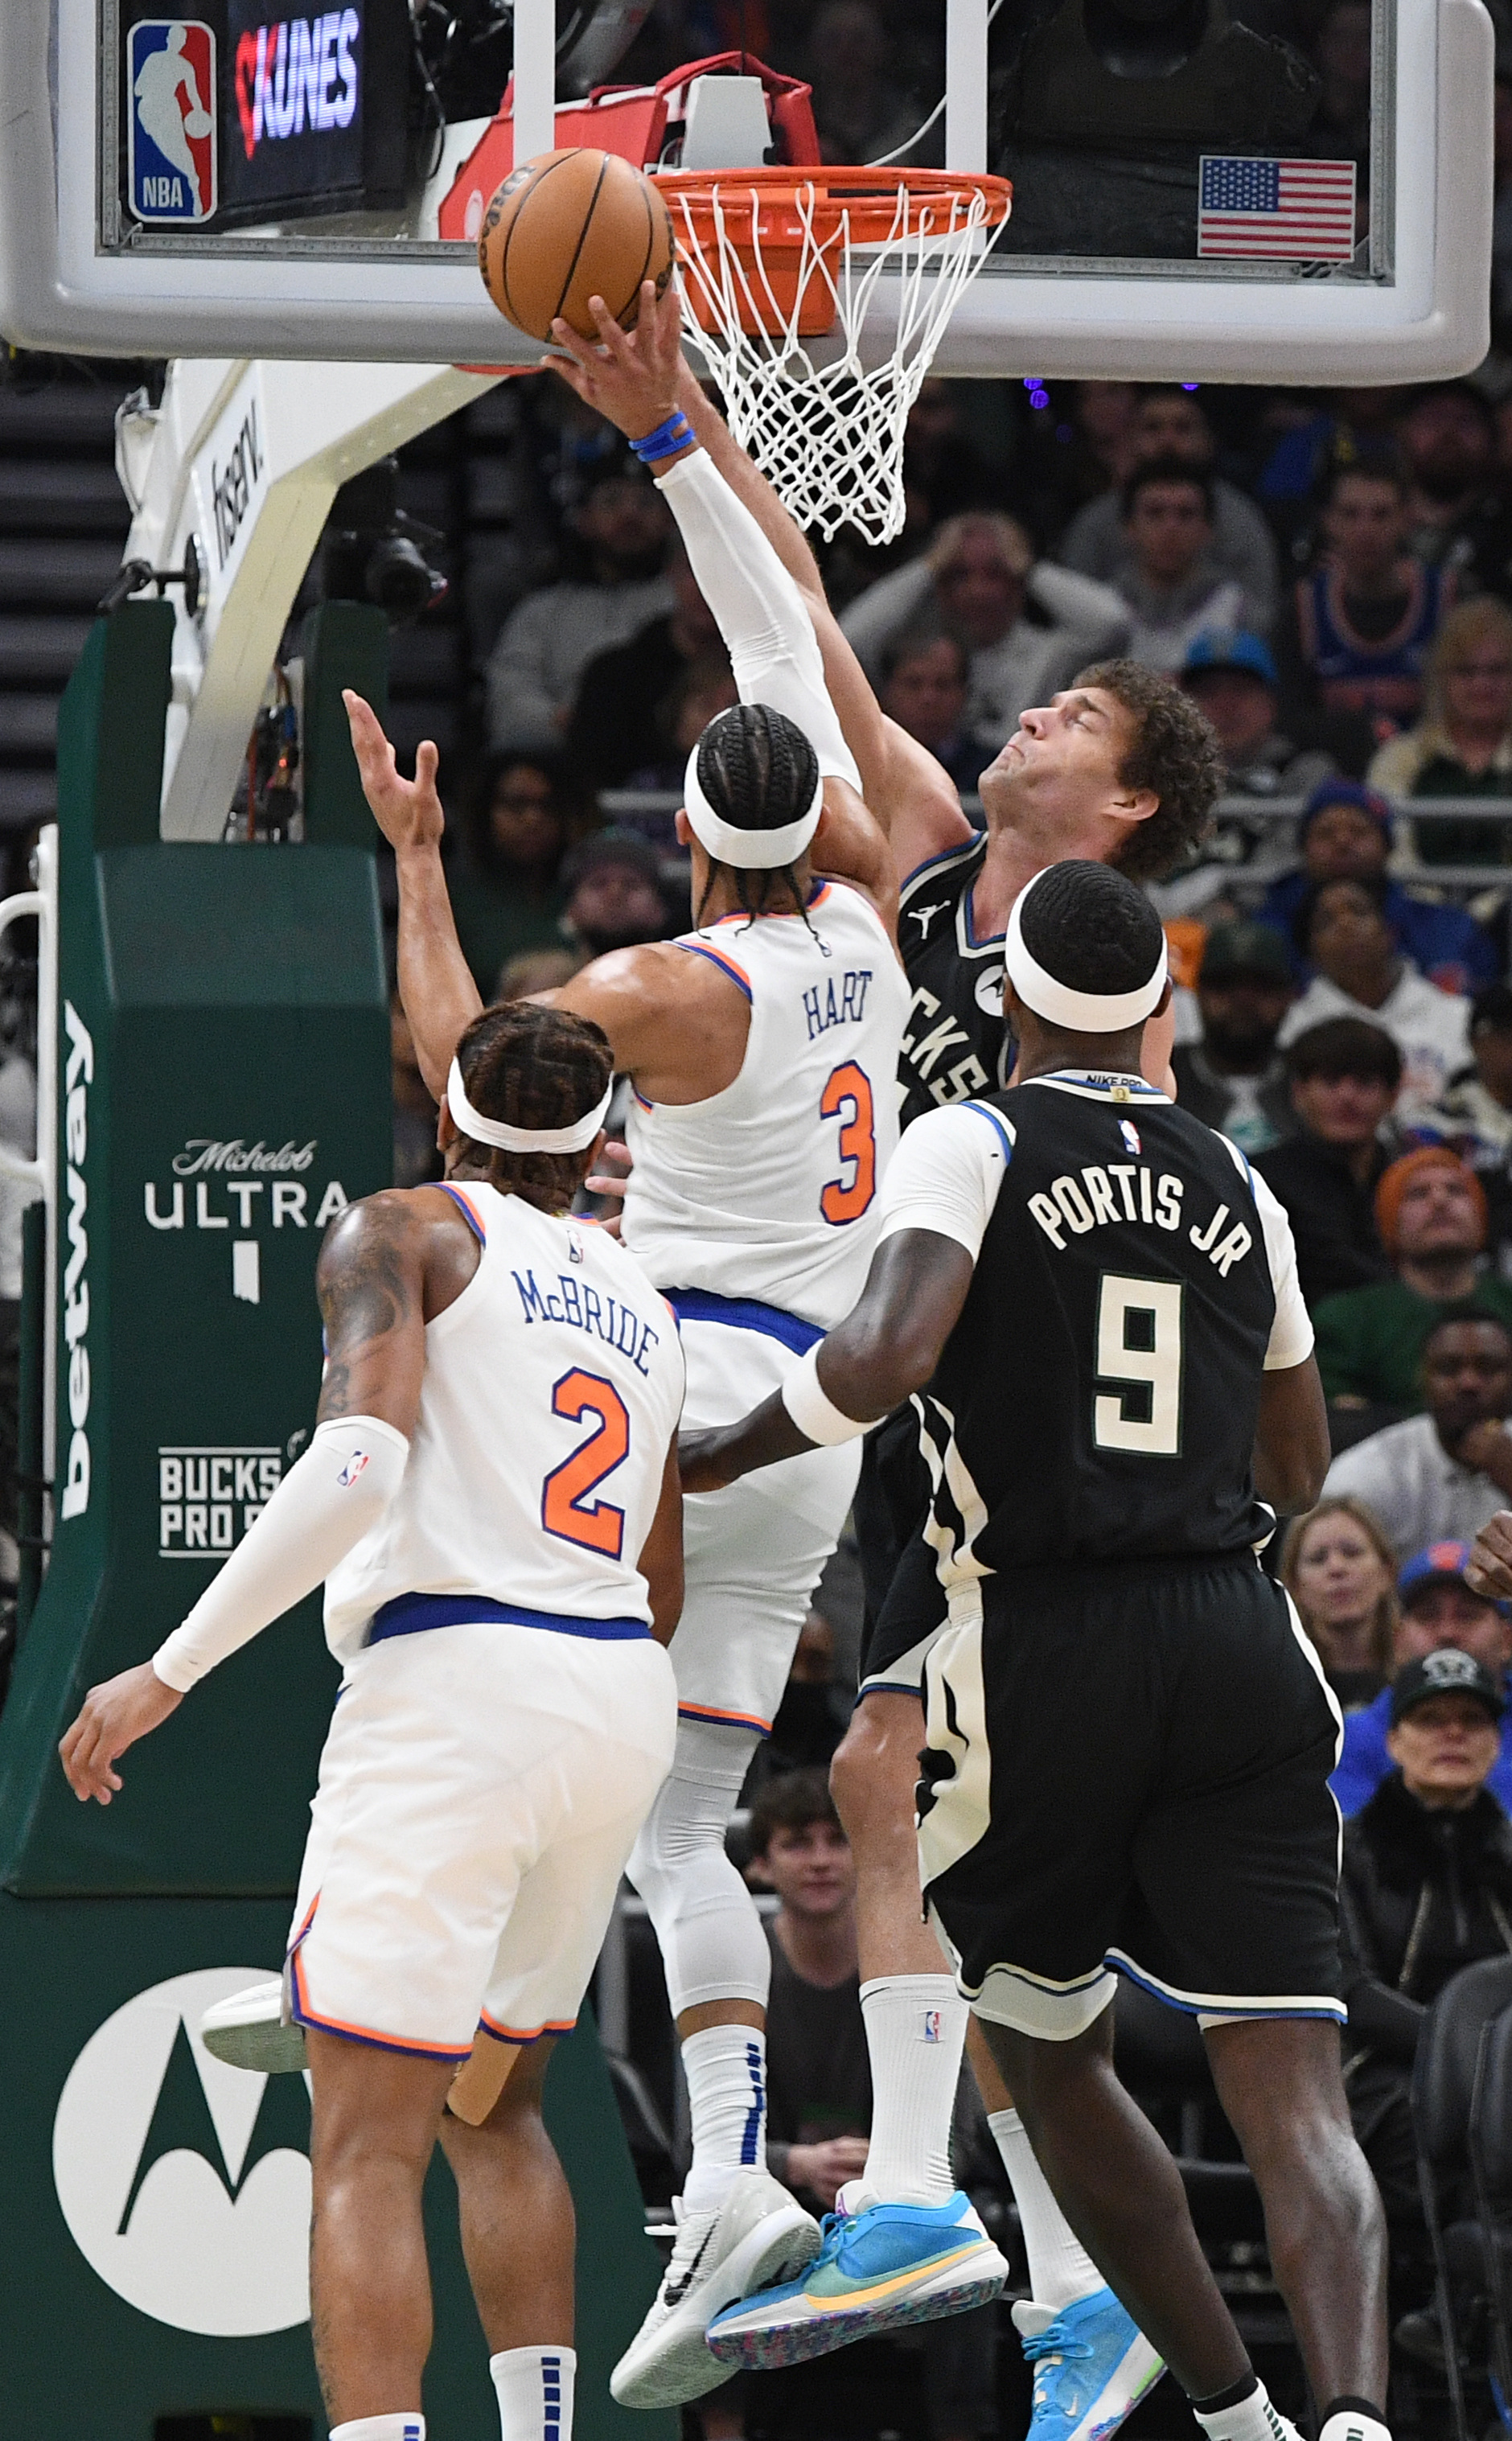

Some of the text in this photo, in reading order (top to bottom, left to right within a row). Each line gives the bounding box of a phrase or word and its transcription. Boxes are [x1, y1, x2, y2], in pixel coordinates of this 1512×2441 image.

[253, 7, 360, 143] KUNES
[143, 176, 183, 208] NBA
[802, 970, 873, 1041] HART
[898, 986, 990, 1107] CKS
[1086, 1075, 1119, 1086] NIKE
[172, 1139, 318, 1175] Michelob
[819, 1059, 877, 1226] 3
[61, 1000, 93, 1519] betway
[145, 1181, 349, 1230] ULTRA
[1027, 1165, 1252, 1278] PORTIS JR
[510, 1269, 659, 1378] McBRIDE
[1094, 1269, 1185, 1458] 9
[160, 1457, 281, 1501] BUCKS
[541, 1366, 630, 1560] 2
[160, 1505, 233, 1547] PRO
